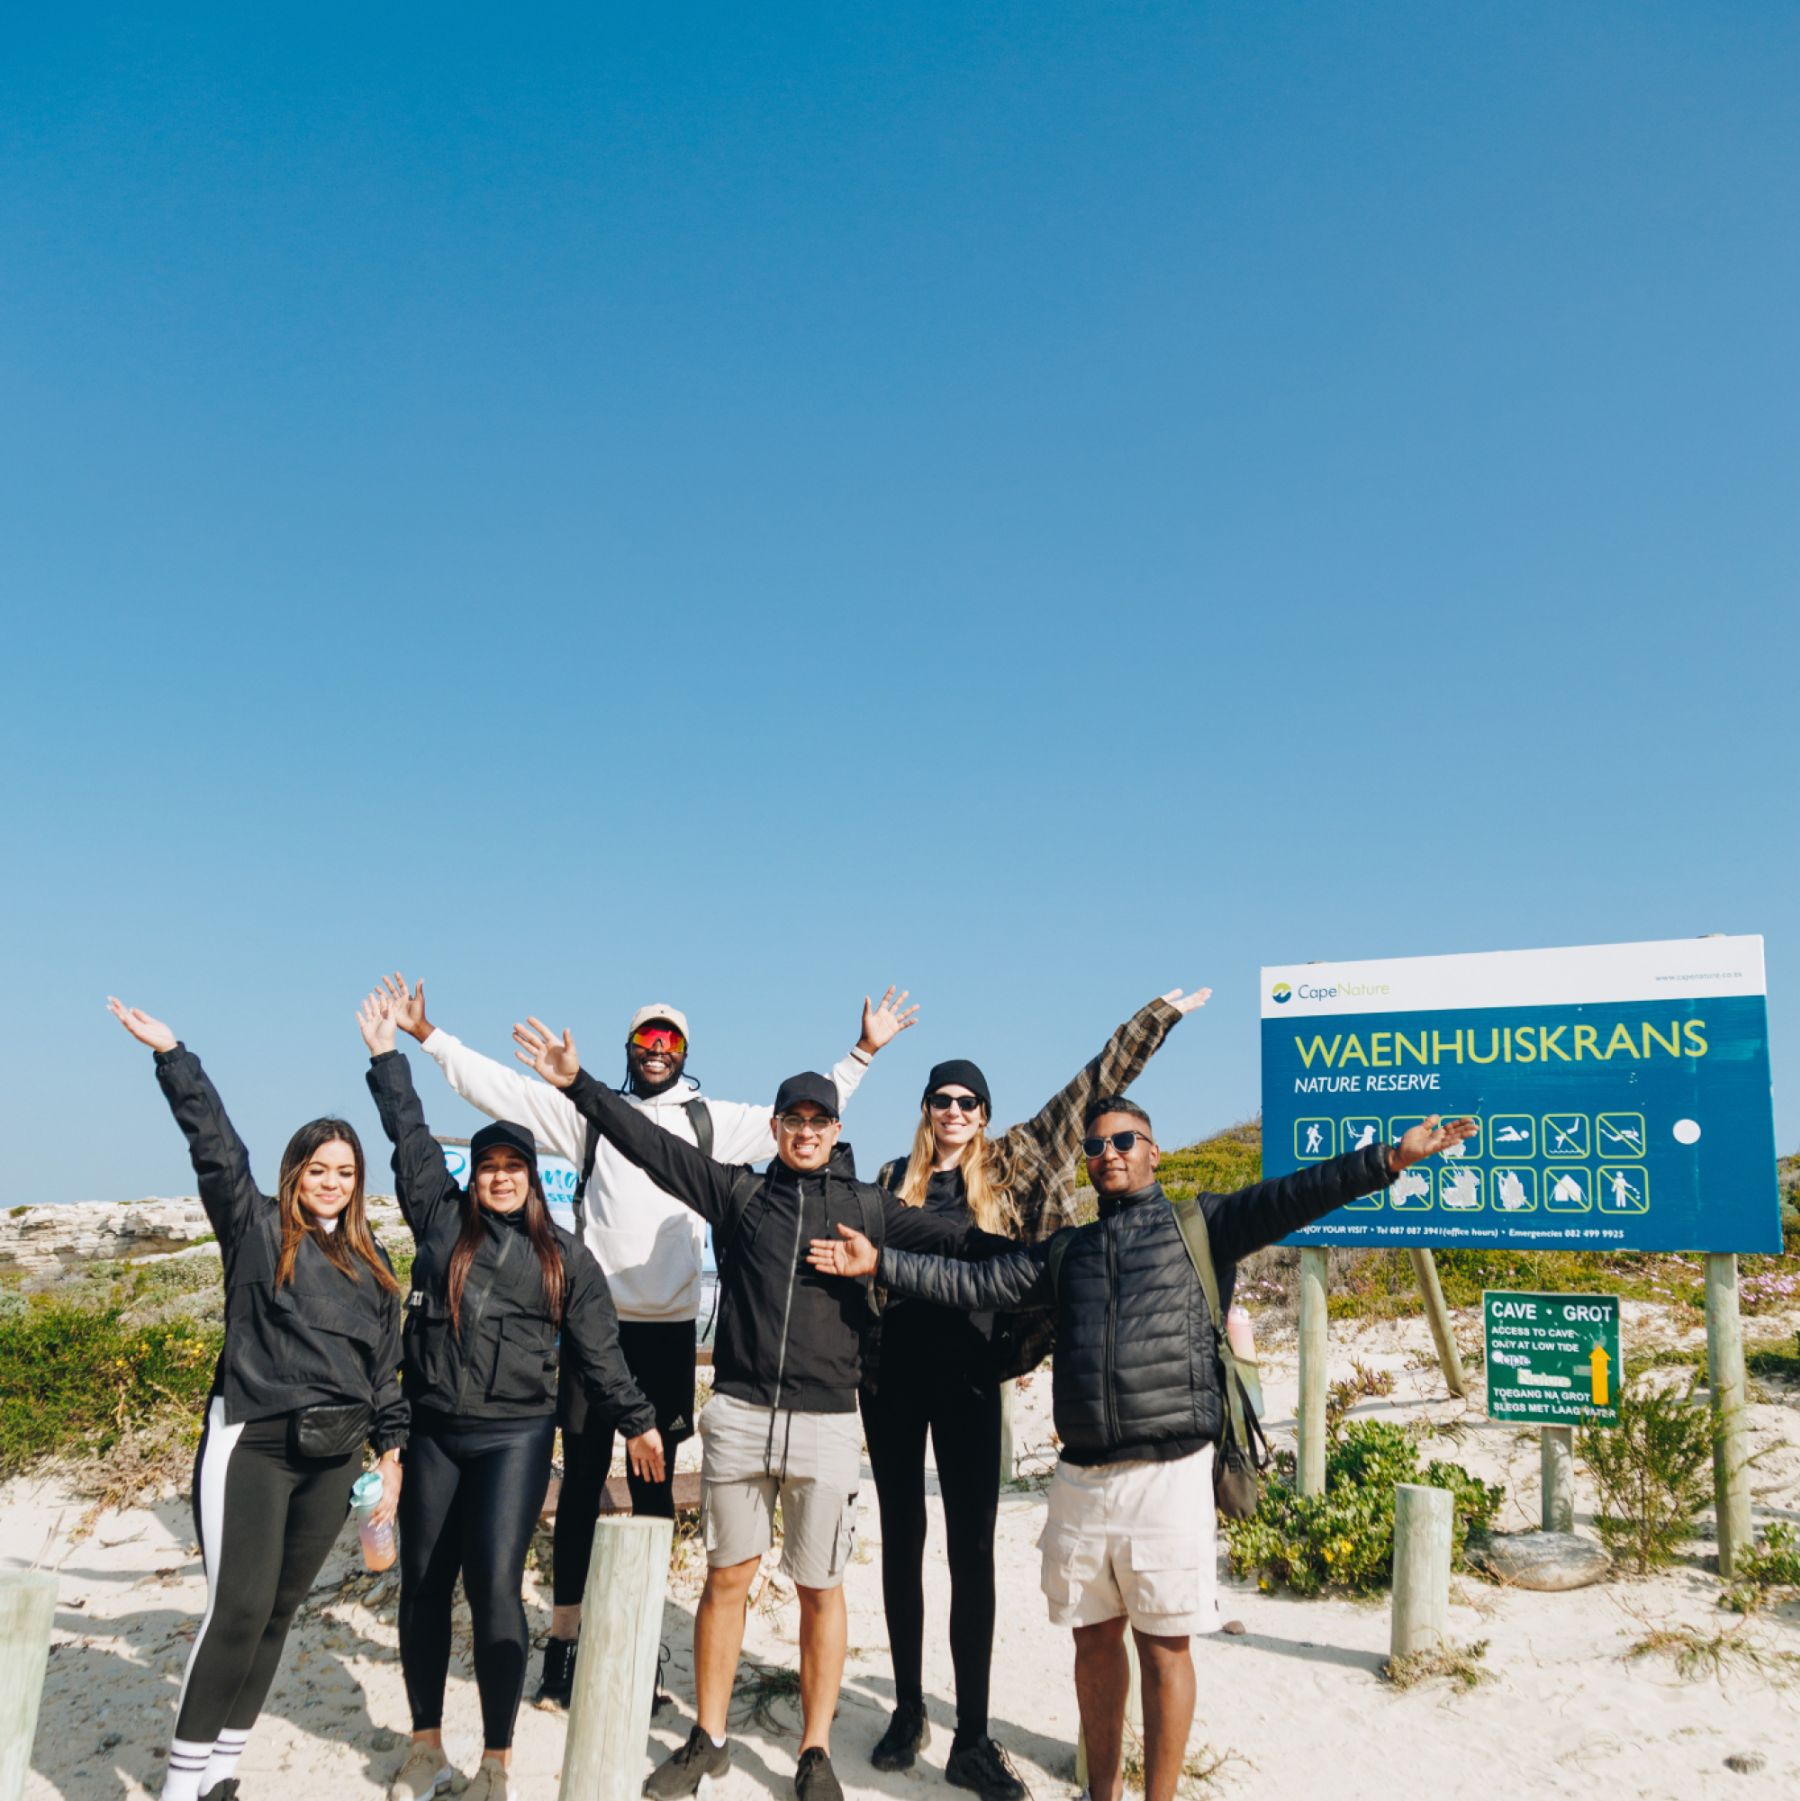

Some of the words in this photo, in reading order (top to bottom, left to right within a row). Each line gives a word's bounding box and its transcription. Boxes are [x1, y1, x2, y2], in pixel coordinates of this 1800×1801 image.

[1294, 1020, 1708, 1069] WAENHUISKRANS
[1294, 1075, 1361, 1093] NATURE
[1366, 1073, 1441, 1092] RESERVE
[1322, 1225, 1346, 1234] YOUR
[1347, 1225, 1368, 1234] VISIT
[1376, 1225, 1388, 1234] Tel
[1471, 1227, 1498, 1239] hours)
[1509, 1228, 1562, 1239] Emergencies
[1491, 1301, 1537, 1320] CAVE
[1563, 1304, 1613, 1322] GROT
[1491, 1325, 1530, 1336] ACCESS
[1532, 1328, 1546, 1337] TO
[1548, 1327, 1575, 1339] CAVE
[1517, 1340, 1530, 1350] AT
[1532, 1341, 1555, 1351] LOW
[1557, 1342, 1580, 1353] TIDE
[1493, 1387, 1542, 1400] TOEGANG
[1544, 1391, 1559, 1401] NA
[1562, 1391, 1591, 1402] GROT
[1493, 1402, 1526, 1413] SLEGS
[1528, 1403, 1549, 1413] MET
